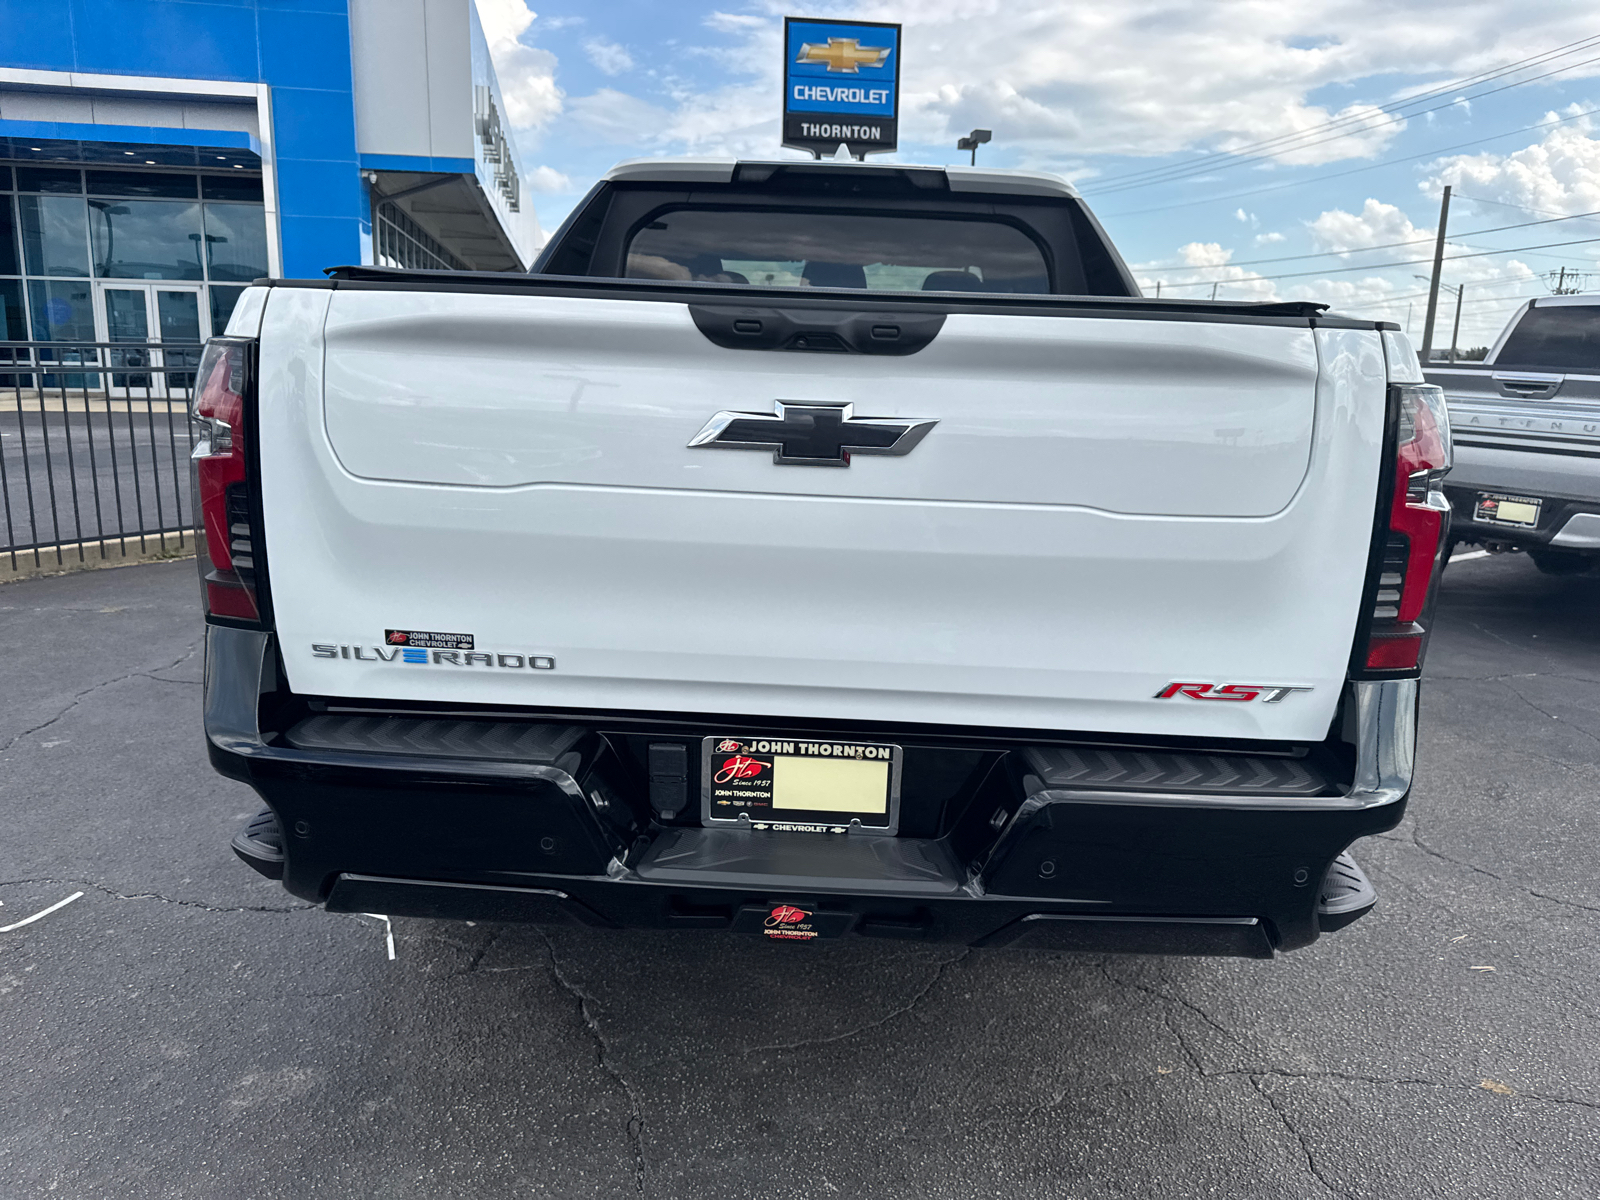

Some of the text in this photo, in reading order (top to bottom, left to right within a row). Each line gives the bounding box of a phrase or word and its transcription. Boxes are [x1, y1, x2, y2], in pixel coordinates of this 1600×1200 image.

[794, 85, 889, 104] CHEVROLET
[801, 123, 881, 140] THORNTON
[409, 632, 472, 643] JOHN THORNTON
[409, 640, 457, 648] CHEVROLET
[311, 642, 556, 670] SILVERADO
[1152, 679, 1316, 703] RST
[749, 741, 890, 759] JOHN THORNTON
[732, 778, 771, 787] Since 1957
[715, 789, 771, 798] JOHN THORNTON
[772, 824, 828, 833] CHEVROLET
